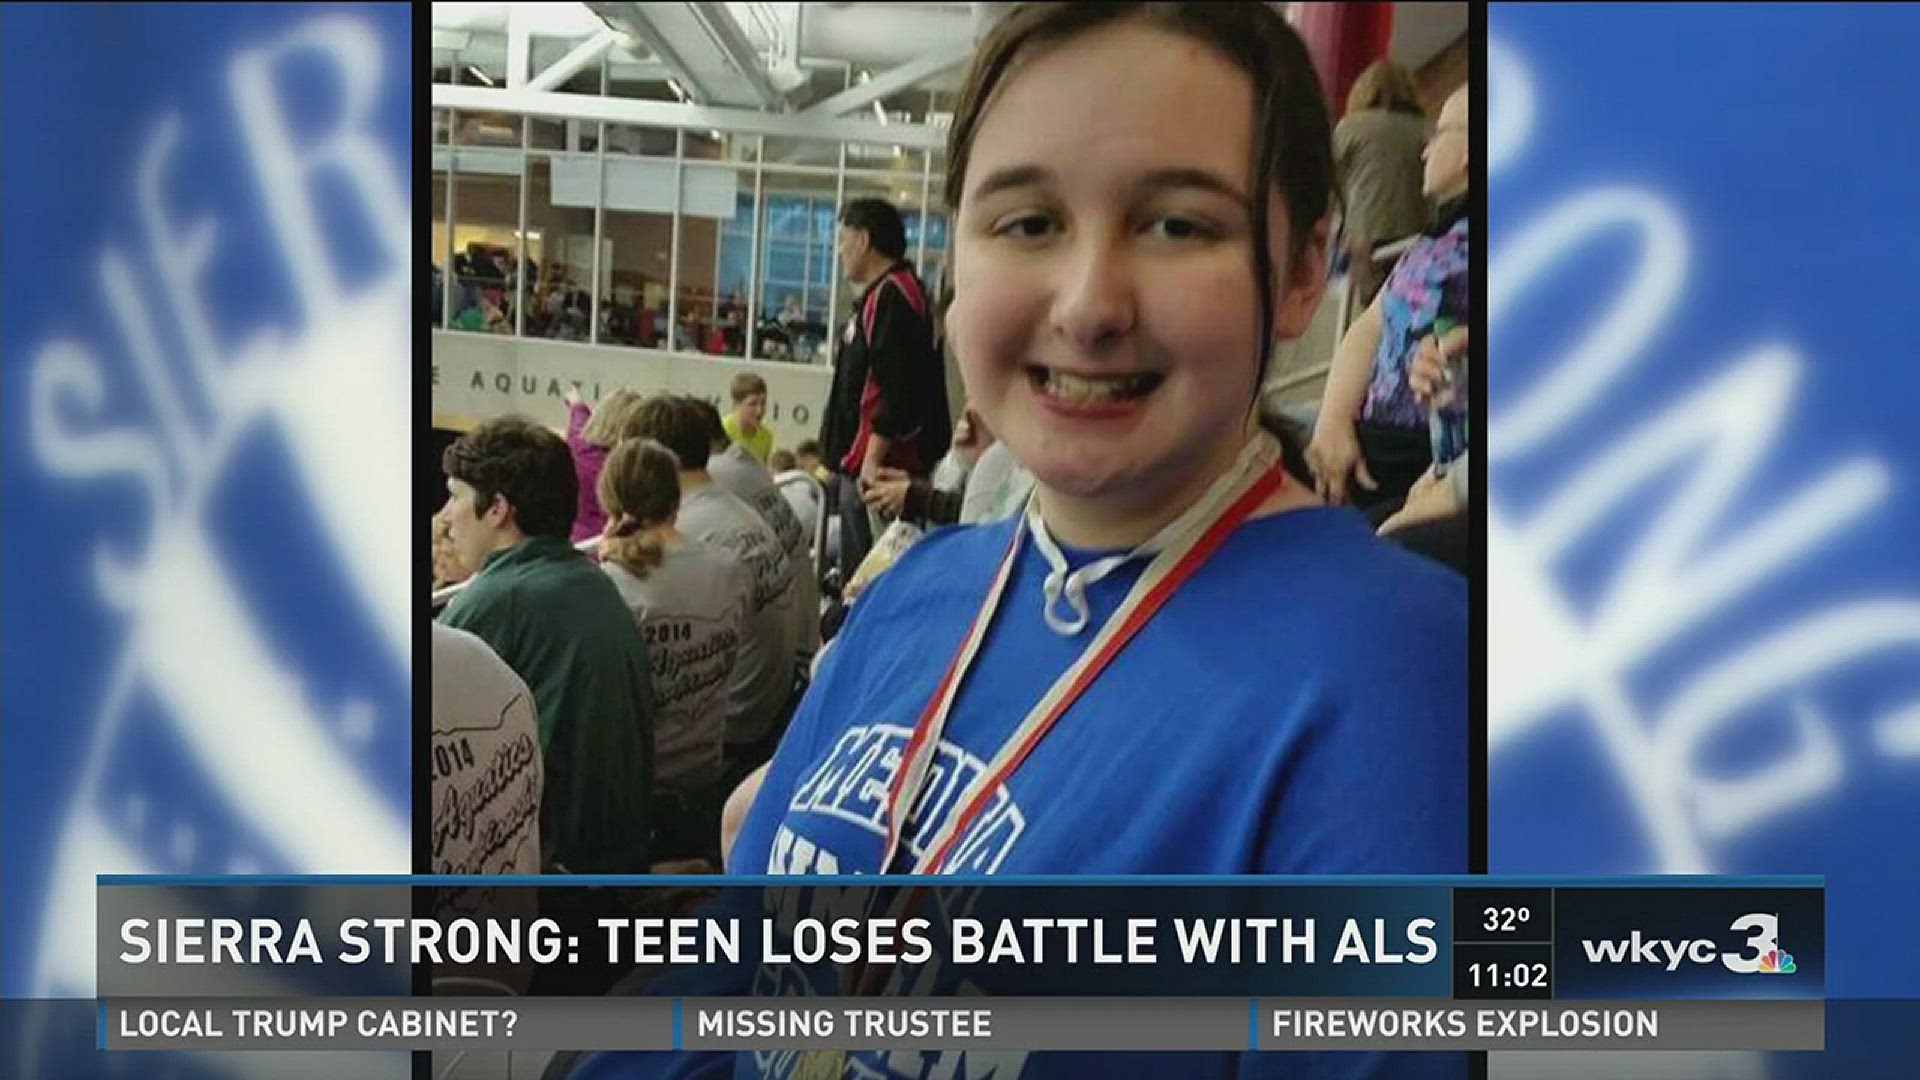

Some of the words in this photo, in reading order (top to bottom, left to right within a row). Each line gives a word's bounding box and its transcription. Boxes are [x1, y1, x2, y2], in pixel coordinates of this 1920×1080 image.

[1488, 30, 1920, 840] ONG
[644, 622, 692, 645] 2014
[431, 737, 475, 780] 014
